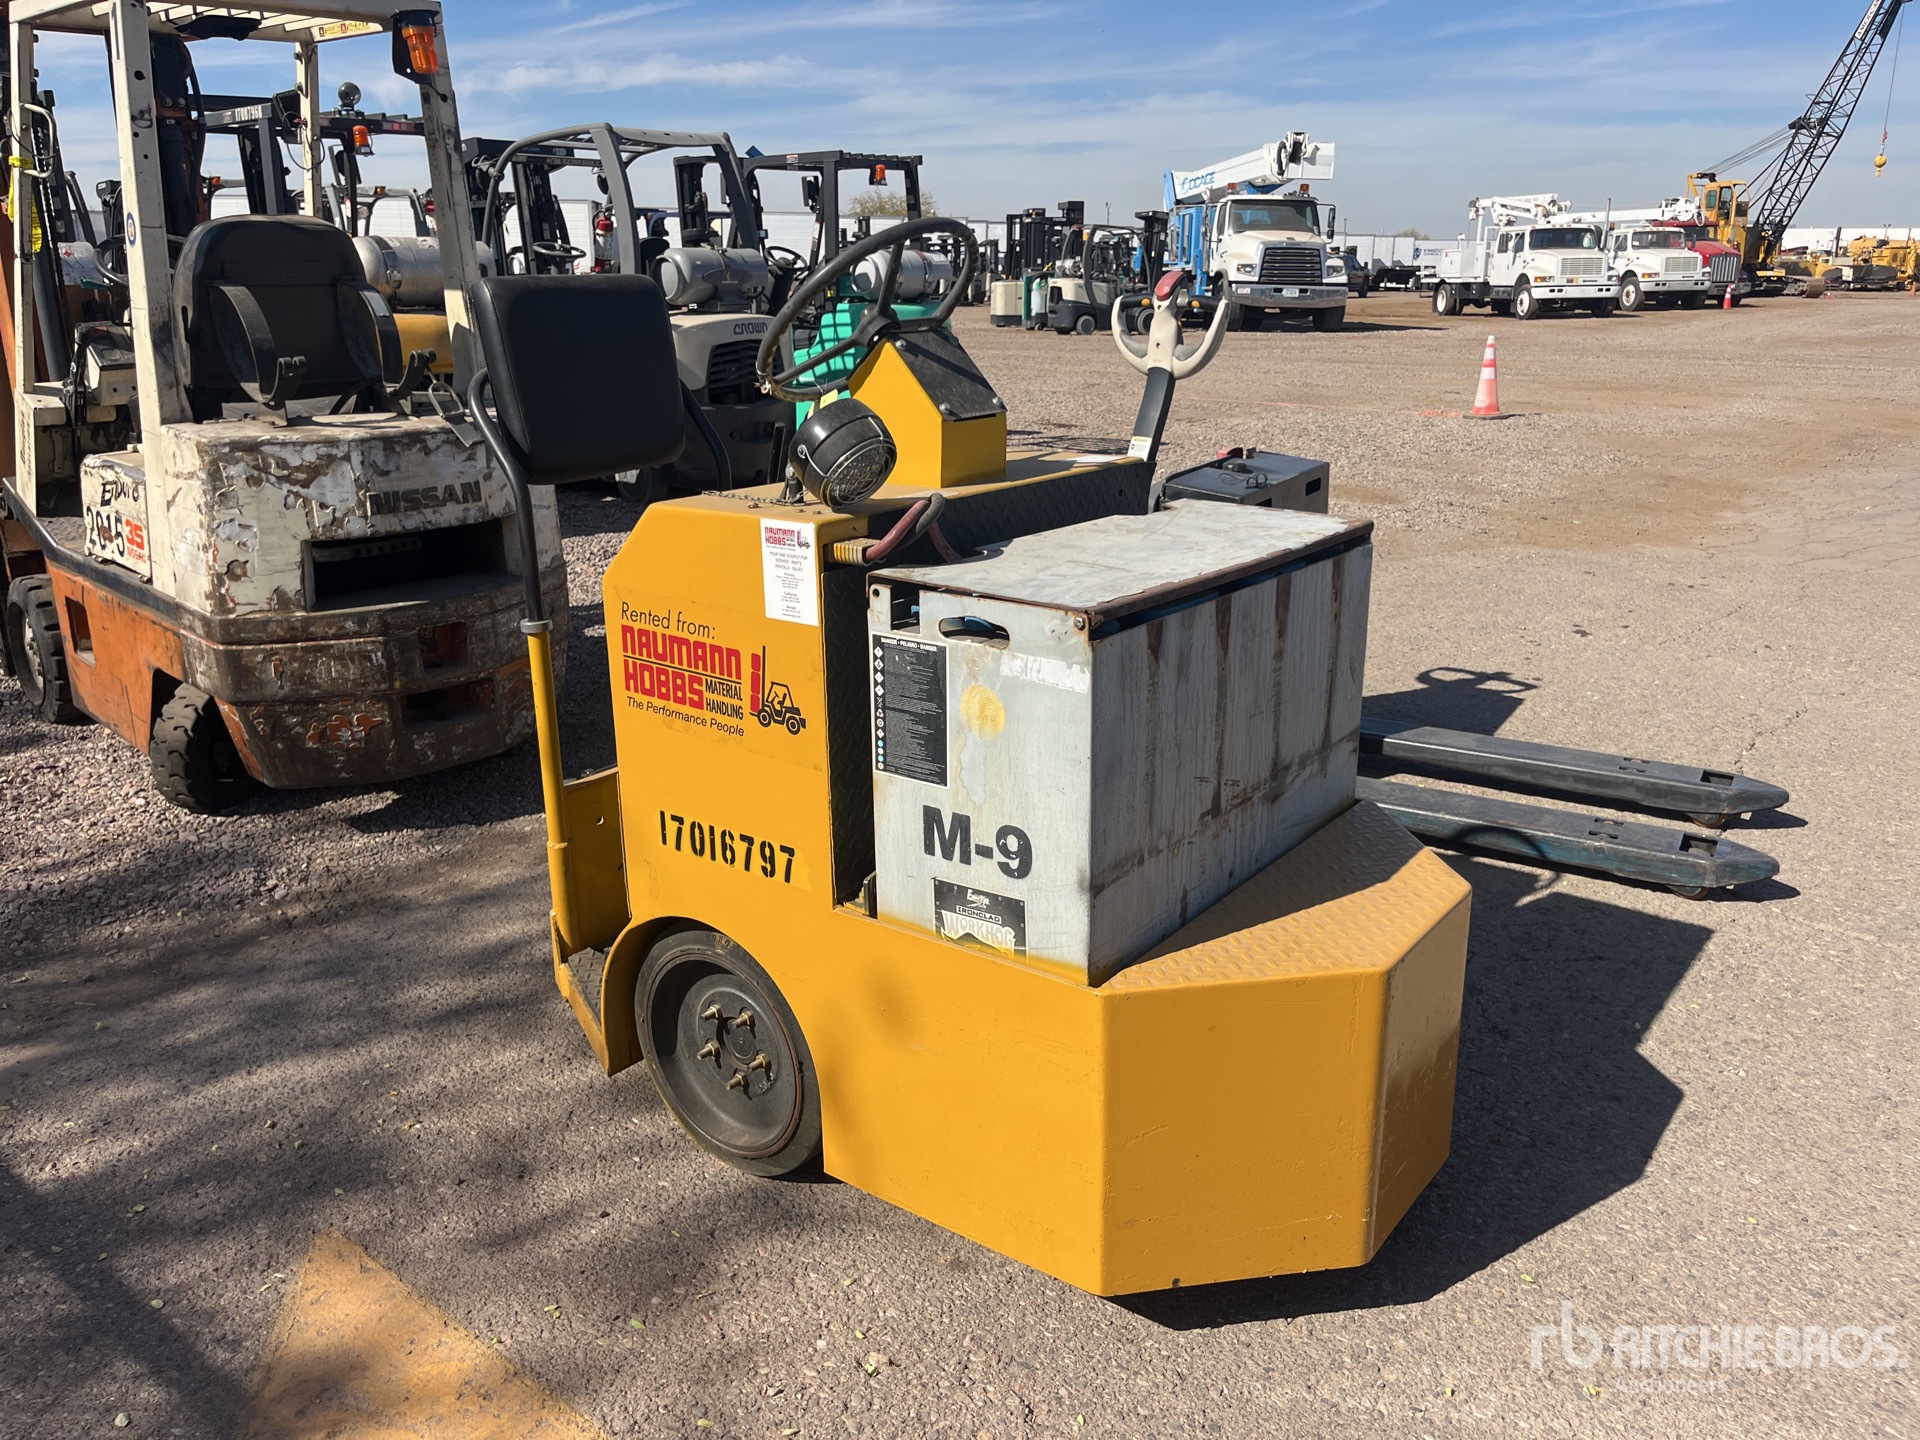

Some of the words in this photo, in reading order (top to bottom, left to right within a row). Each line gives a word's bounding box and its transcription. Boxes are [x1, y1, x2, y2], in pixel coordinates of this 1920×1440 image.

[733, 322, 769, 335] CROWN
[369, 480, 483, 516] NISSAN
[124, 517, 145, 551] 35
[765, 527, 796, 537] NAUMANN
[765, 535, 786, 546] HOBBS
[621, 601, 671, 630] Rented
[676, 611, 716, 640] from:
[621, 623, 742, 681] NAUMANN
[623, 658, 704, 711] HOBBS
[704, 677, 743, 701] MATERIAL
[626, 695, 645, 710] The
[645, 701, 708, 727] Performance
[709, 718, 745, 737] People
[705, 697, 744, 720] HANDLING
[659, 810, 796, 884] 17016797
[922, 804, 1033, 880] M-9
[941, 909, 1016, 950] WORKHOG
[956, 906, 1001, 924] IRONCLAD
